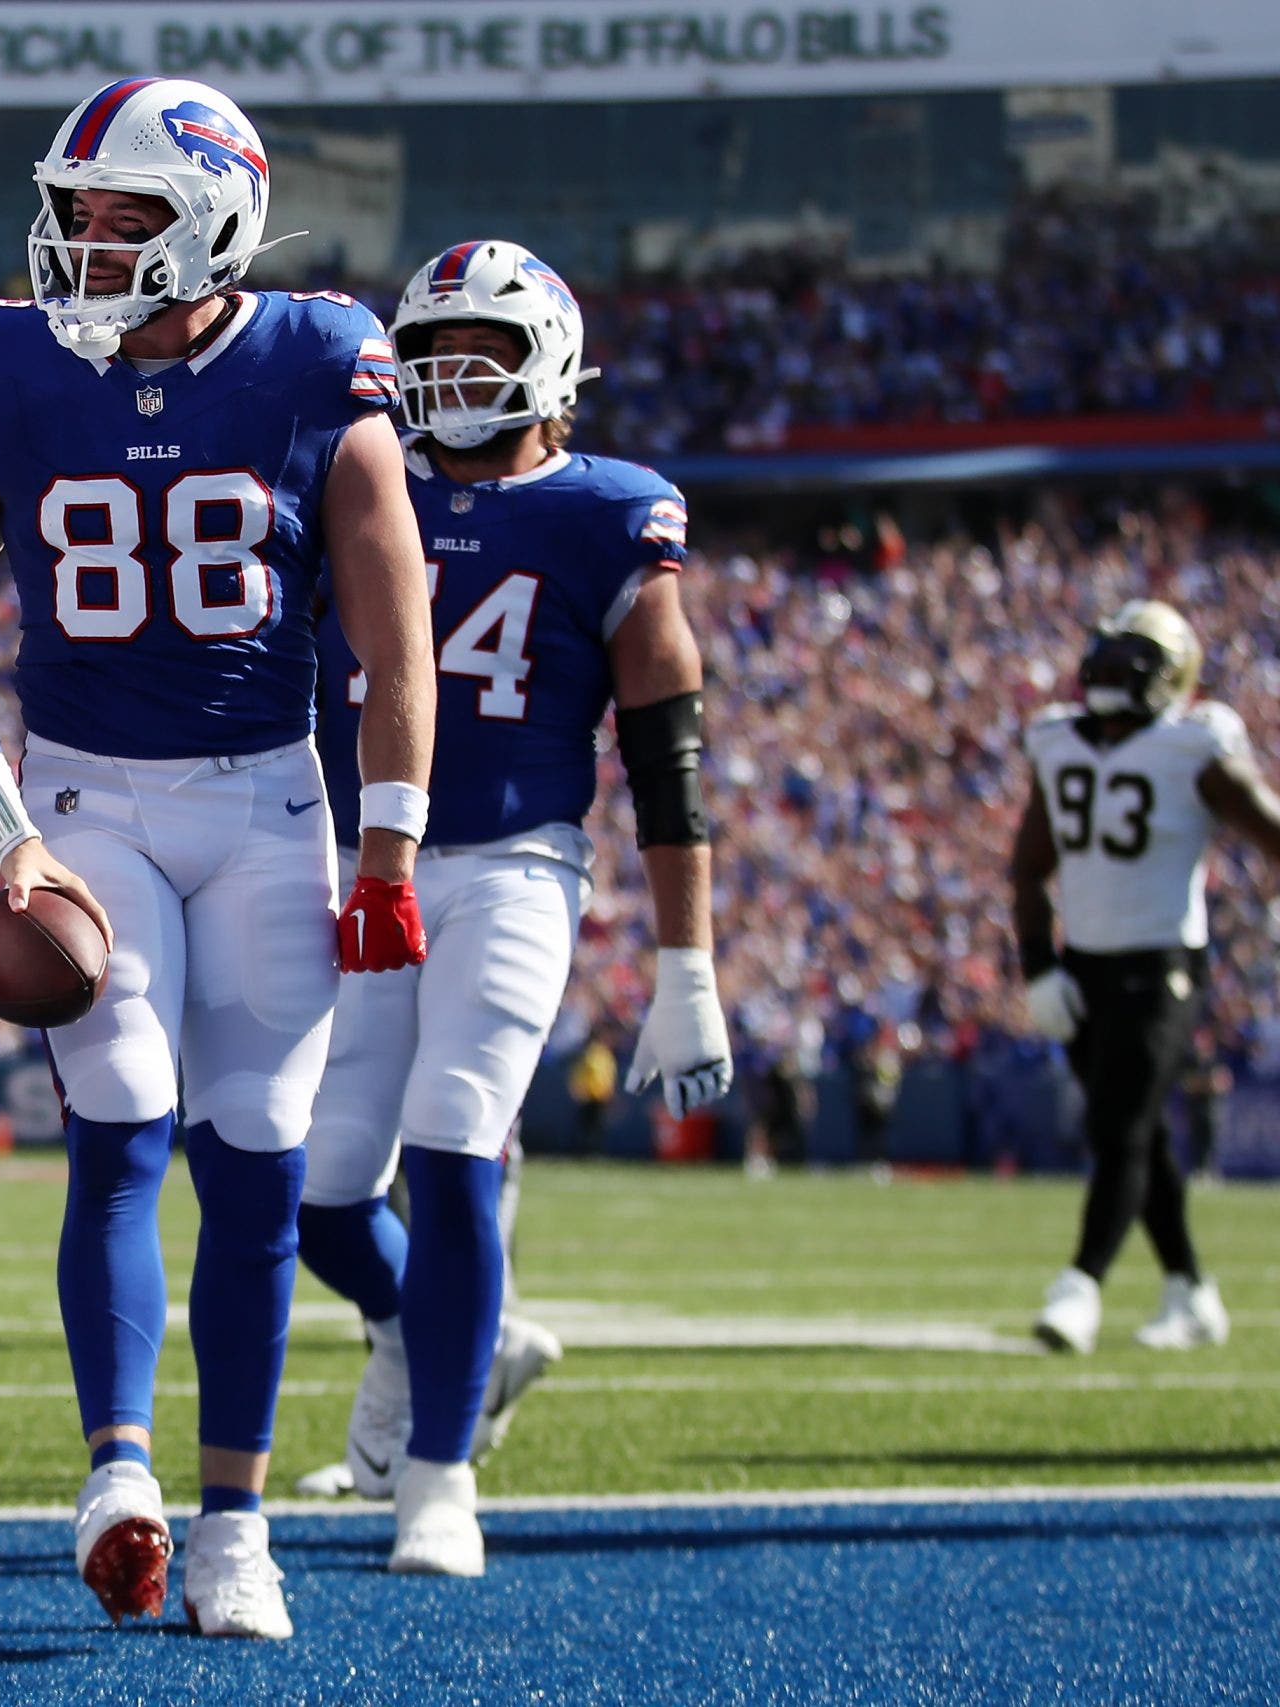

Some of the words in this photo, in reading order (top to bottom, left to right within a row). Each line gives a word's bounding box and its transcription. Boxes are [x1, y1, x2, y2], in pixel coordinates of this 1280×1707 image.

[158, 21, 312, 75] BANK
[325, 19, 401, 75] OF
[417, 18, 523, 75] THE
[540, 12, 786, 71] BUFFALO
[797, 6, 951, 64] BILLS
[142, 399, 160, 411] NFL
[126, 445, 181, 460] BILLS
[37, 467, 276, 643] 88
[433, 537, 481, 553] BILLS
[1056, 765, 1155, 862] 93
